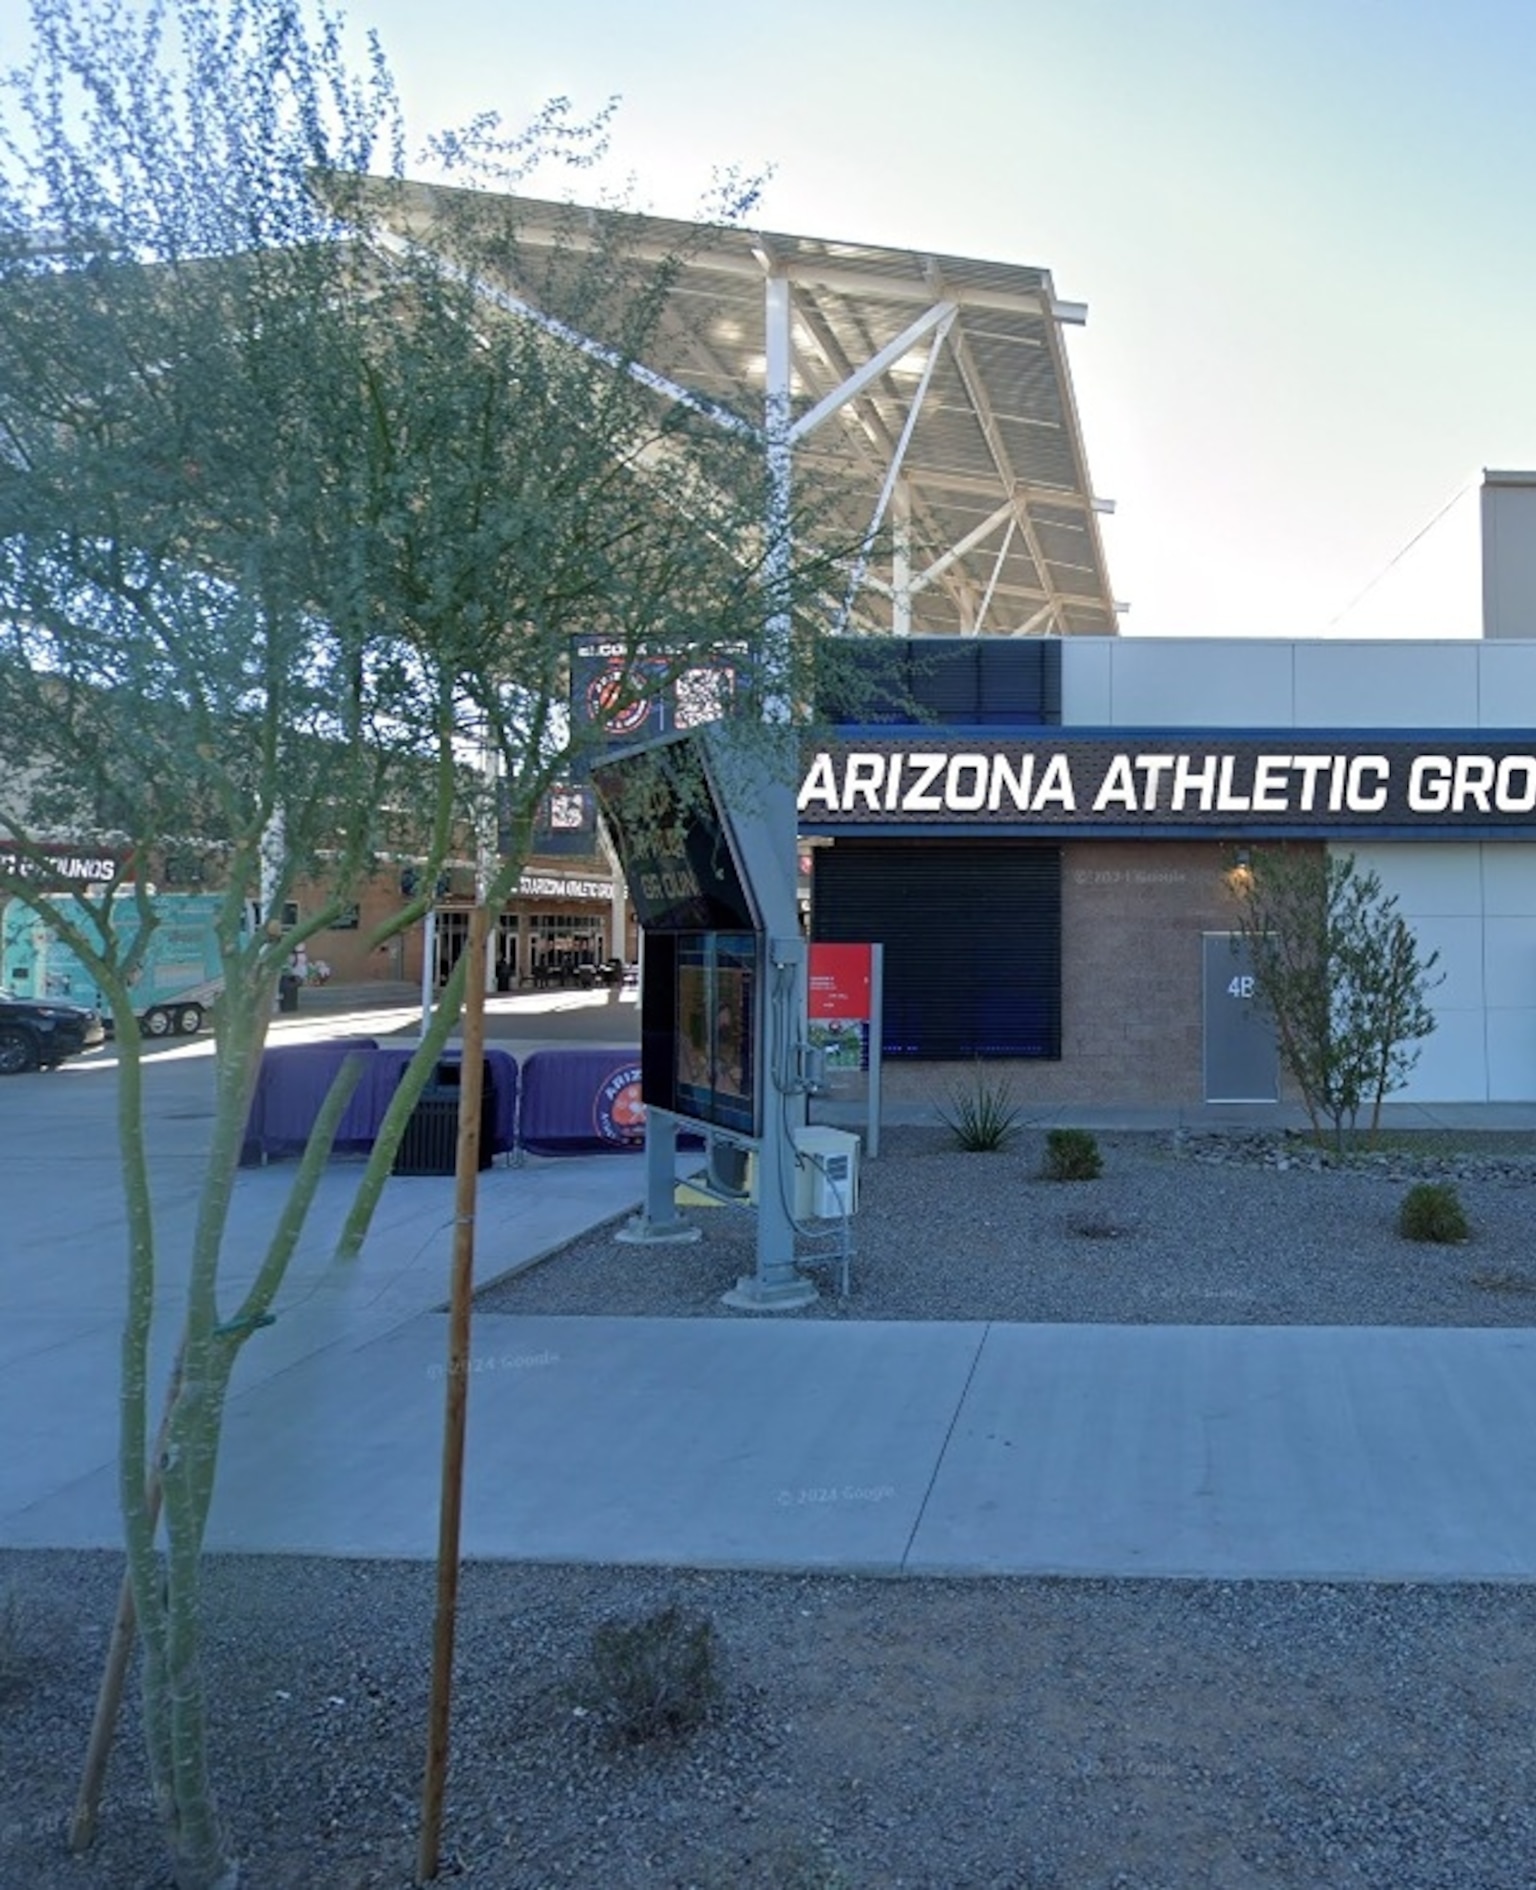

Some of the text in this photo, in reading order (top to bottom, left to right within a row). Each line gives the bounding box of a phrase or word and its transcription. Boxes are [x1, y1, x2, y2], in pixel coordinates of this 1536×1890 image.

[796, 753, 1076, 811] ARIZONA
[1092, 753, 1390, 812] ATHLETIC
[1227, 976, 1255, 998] 4B
[605, 1069, 642, 1100] ARIZ
